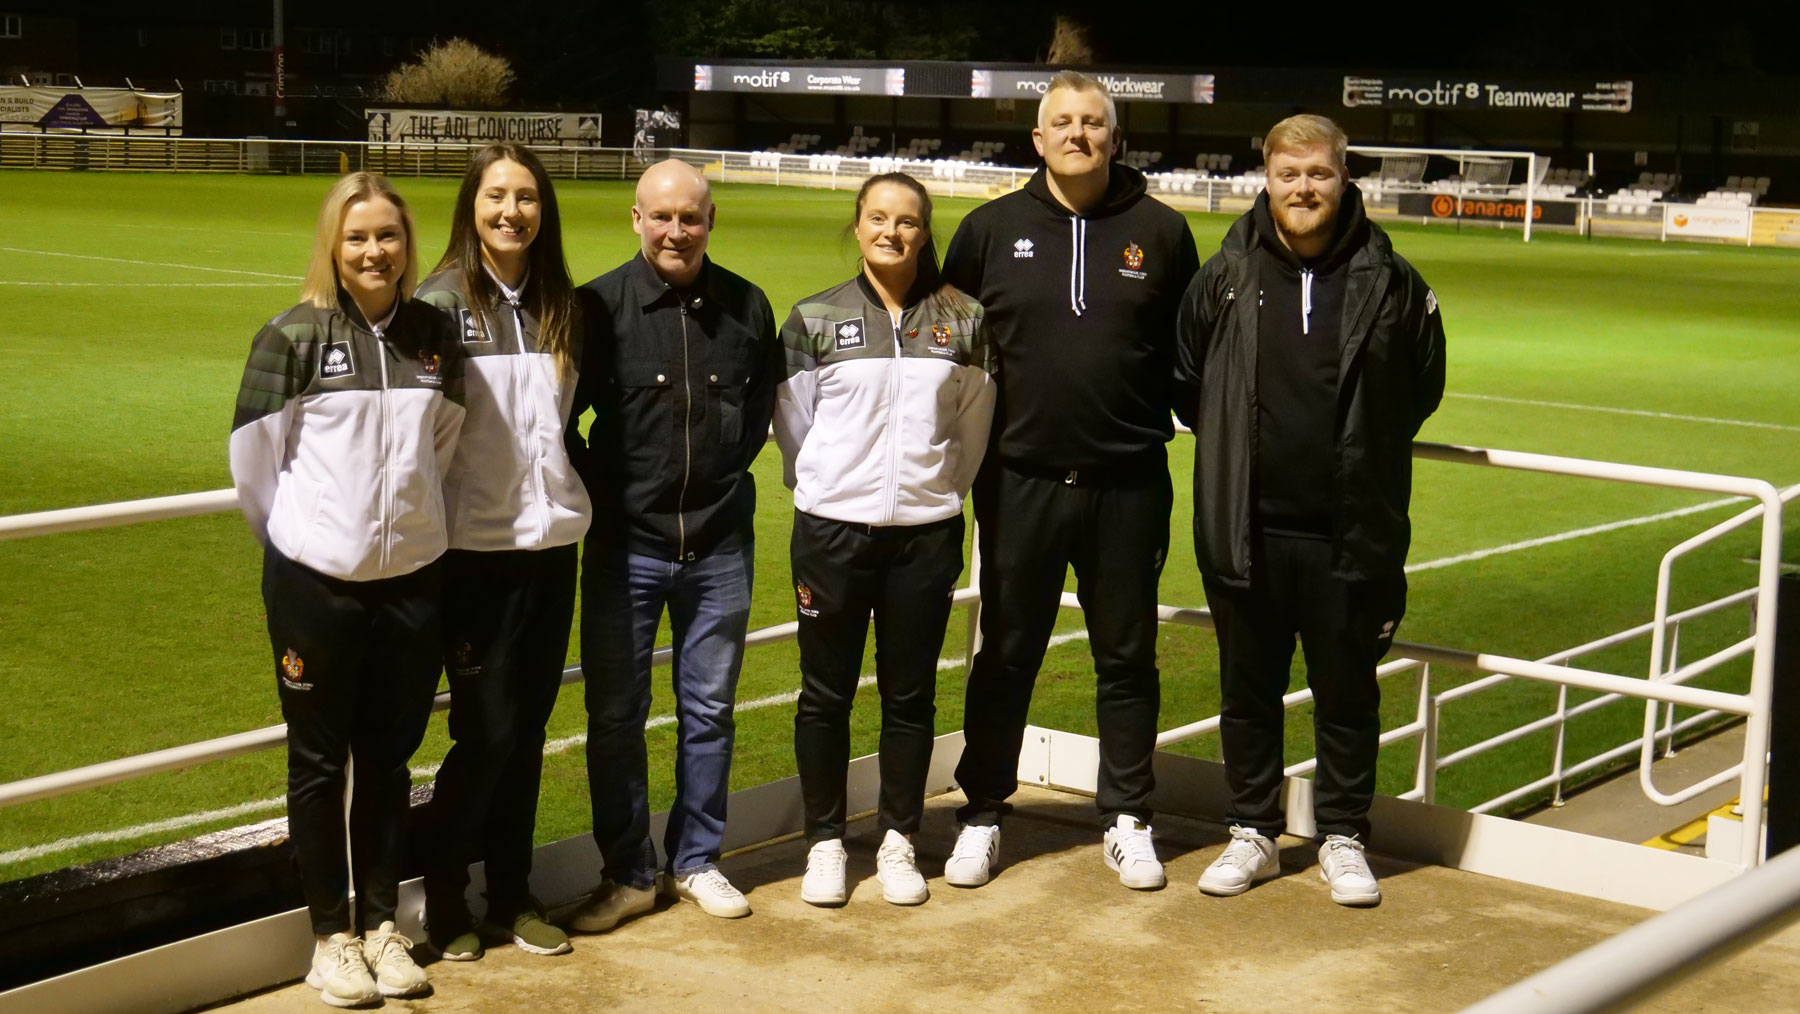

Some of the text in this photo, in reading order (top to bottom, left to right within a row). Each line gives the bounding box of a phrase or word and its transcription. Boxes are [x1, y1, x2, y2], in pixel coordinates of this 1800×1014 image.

[1097, 76, 1165, 93] Workwear
[14, 97, 35, 105] BUILD
[1485, 84, 1575, 108] Teamwear
[410, 115, 439, 139] THE
[477, 116, 563, 141] CONCOURSE
